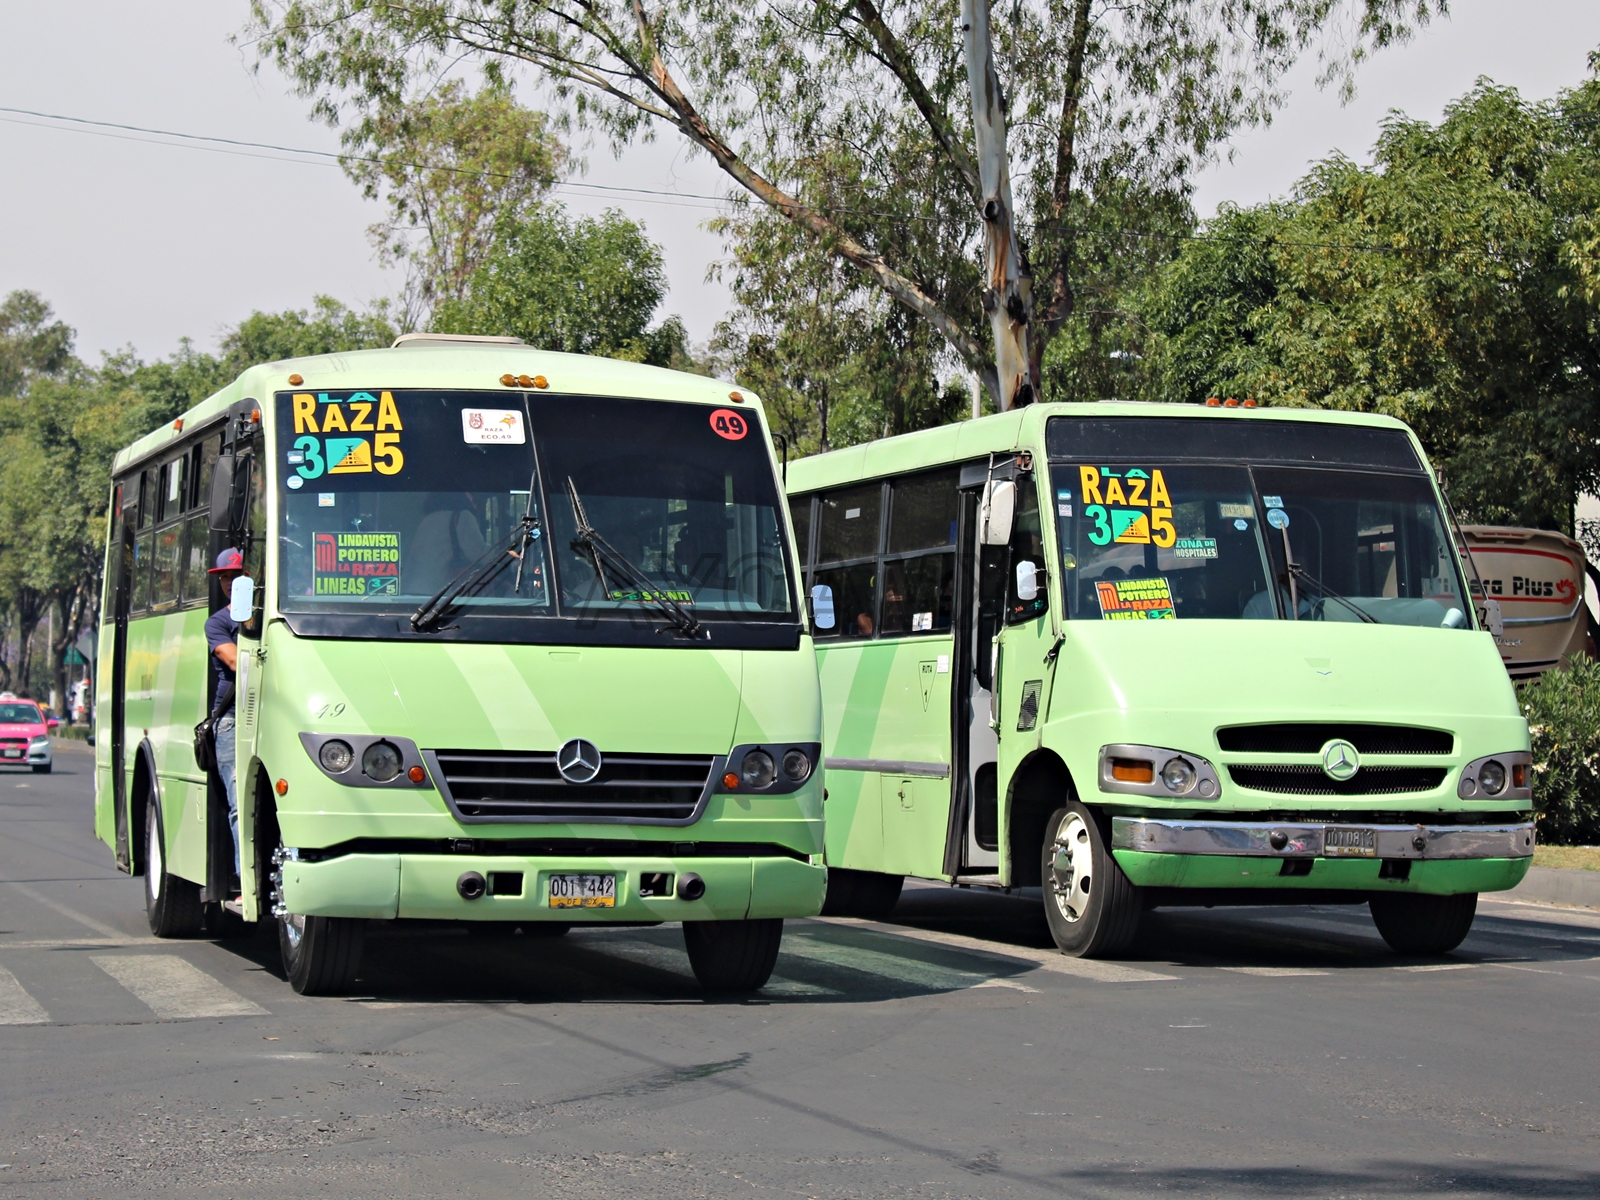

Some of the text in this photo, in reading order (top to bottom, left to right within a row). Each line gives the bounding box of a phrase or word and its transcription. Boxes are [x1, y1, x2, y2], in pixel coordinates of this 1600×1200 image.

[292, 391, 403, 434] RAZA
[716, 416, 744, 435] 49
[293, 433, 404, 479] 3 5
[1079, 466, 1172, 508] RAZA
[1085, 504, 1177, 549] 3 5
[338, 534, 398, 547] LINDAVISTA
[1175, 540, 1203, 548] ZONA
[338, 549, 399, 562] POTRERO
[1175, 549, 1217, 557] HOSPITALES
[338, 563, 398, 576] LA RAZA
[316, 577, 396, 595] LINEAS 3 5
[1115, 578, 1167, 592] LINDAVISTA
[1512, 576, 1553, 596] Plus
[1118, 589, 1170, 602] POTRERO
[1132, 598, 1173, 610] RAZA
[314, 702, 346, 719] 49
